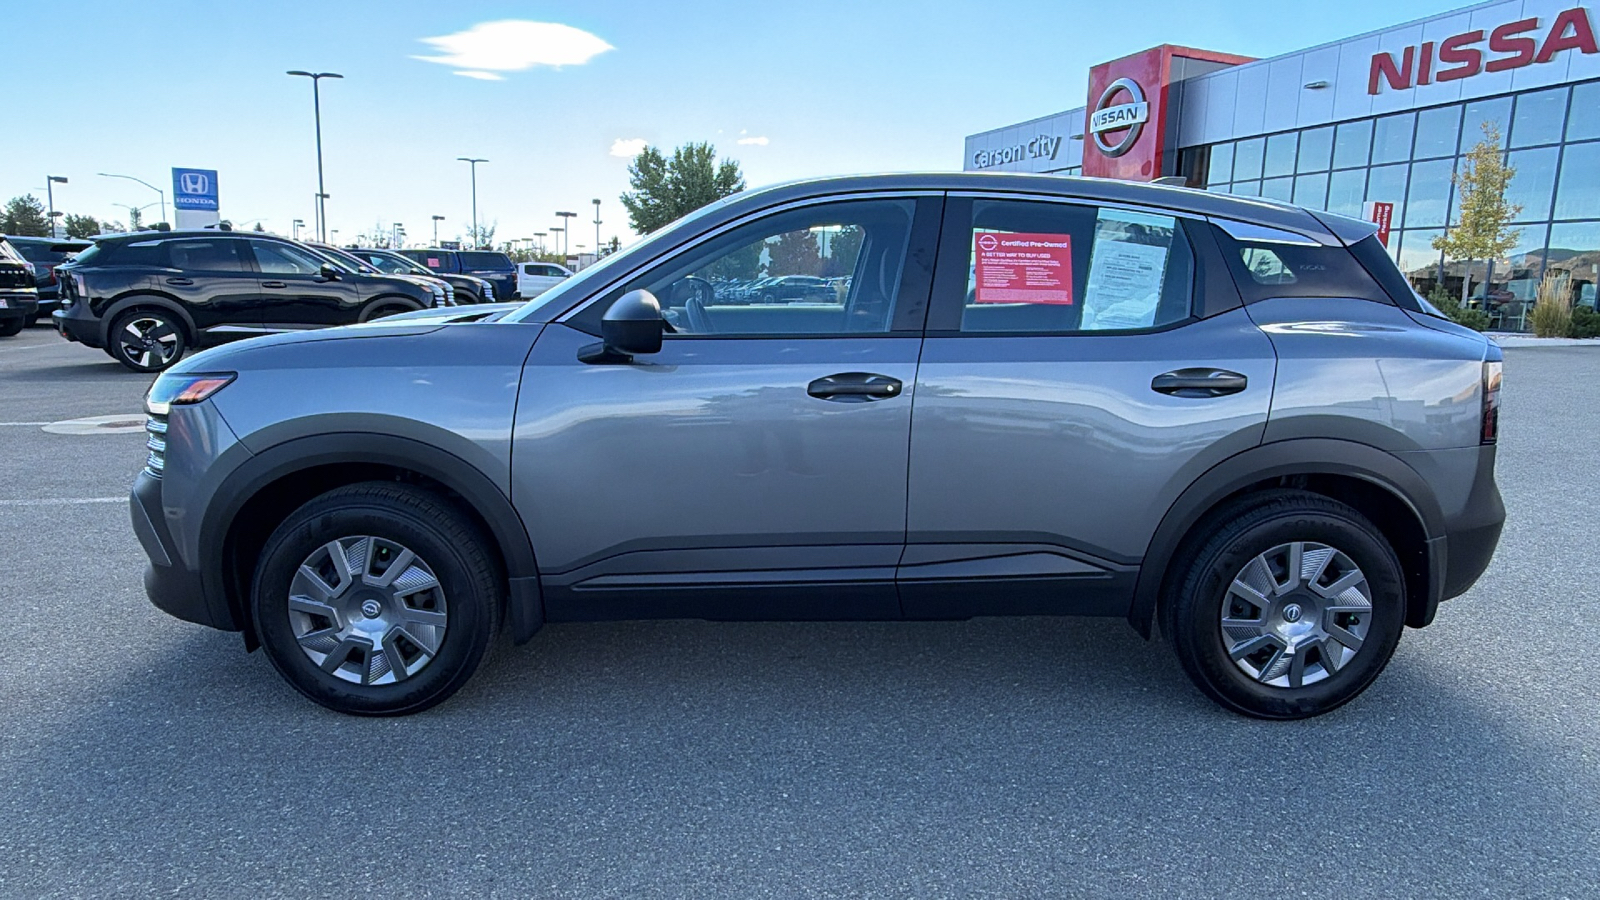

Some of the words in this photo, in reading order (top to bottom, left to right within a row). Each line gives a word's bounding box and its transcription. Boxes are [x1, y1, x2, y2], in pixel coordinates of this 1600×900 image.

[1368, 7, 1599, 95] NISSA
[1093, 106, 1138, 127] NISSAN
[973, 144, 1022, 168] Carson
[1026, 134, 1060, 160] City
[176, 197, 216, 205] HONDA
